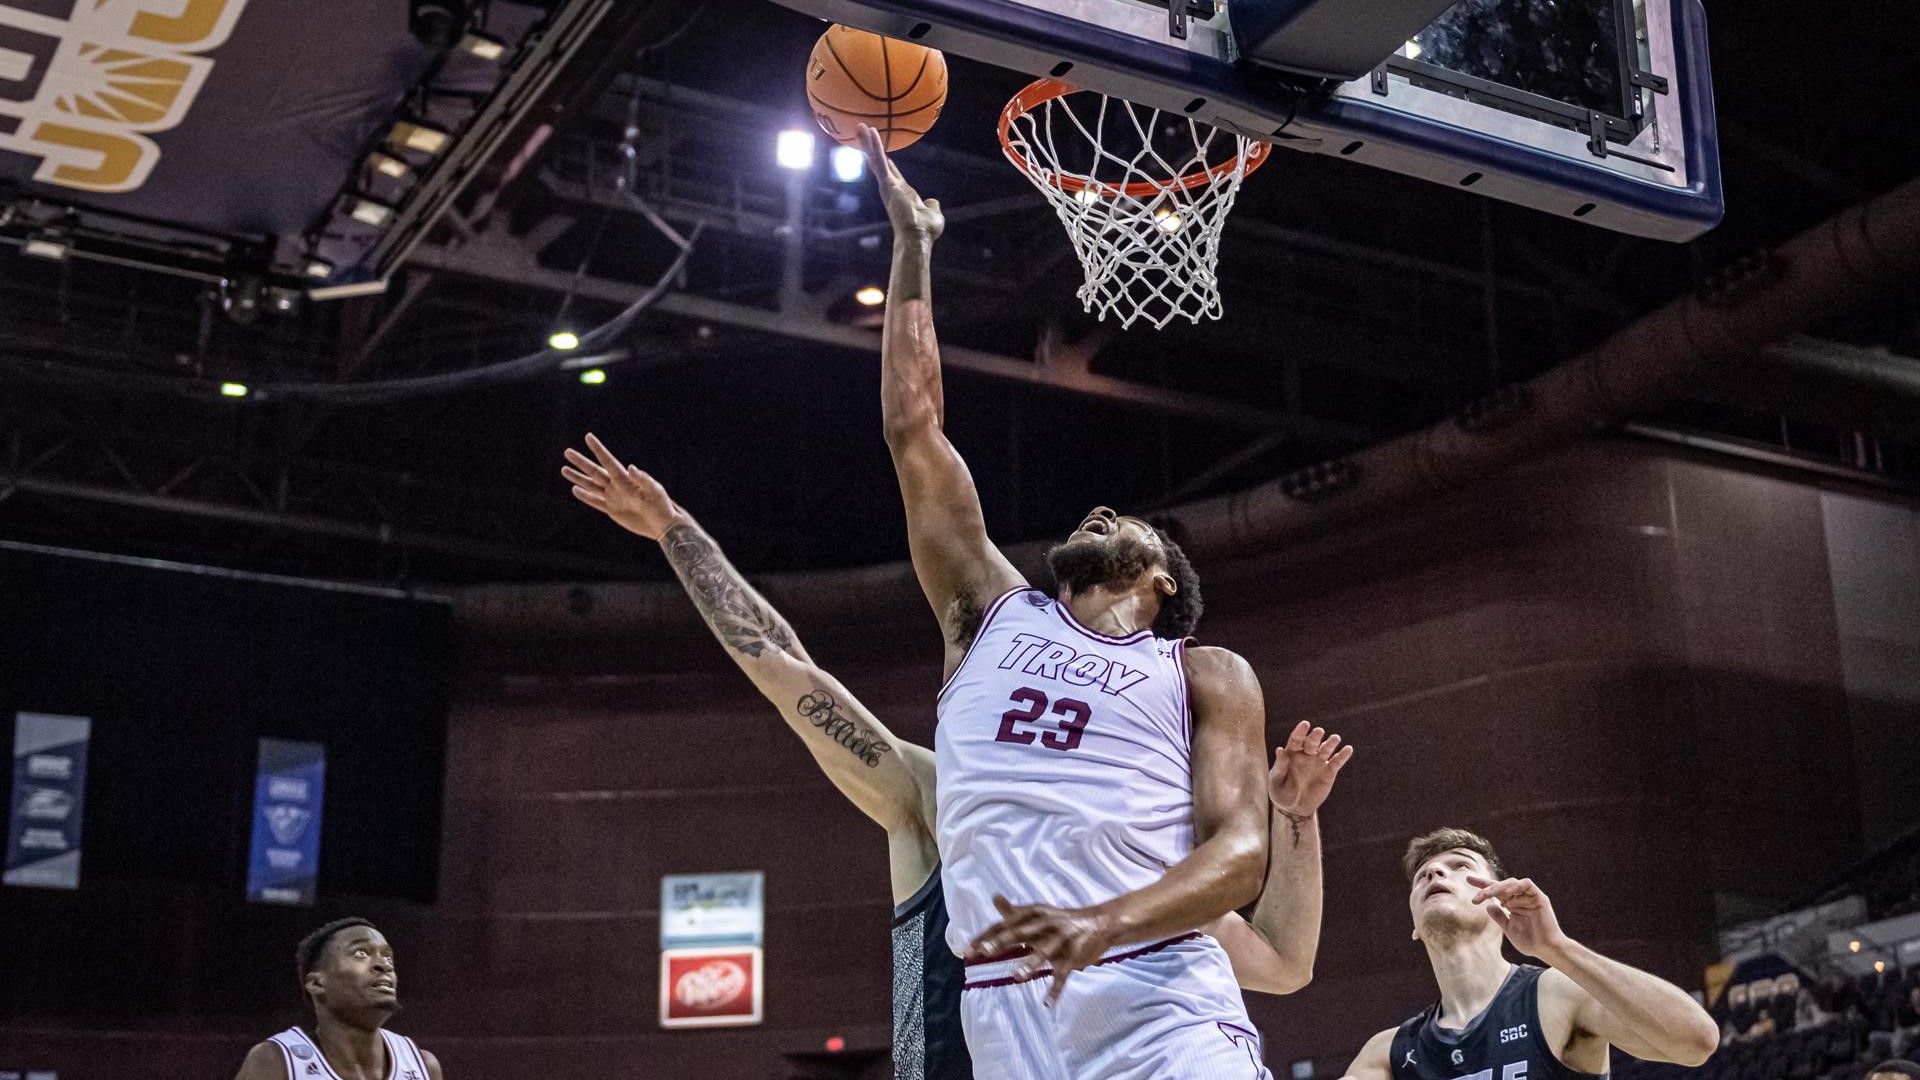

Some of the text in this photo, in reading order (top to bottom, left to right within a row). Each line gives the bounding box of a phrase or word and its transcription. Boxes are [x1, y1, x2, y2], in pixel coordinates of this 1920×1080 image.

[998, 633, 1149, 696] TROY
[995, 687, 1092, 751] 23
[1500, 1024, 1528, 1043] SBC
